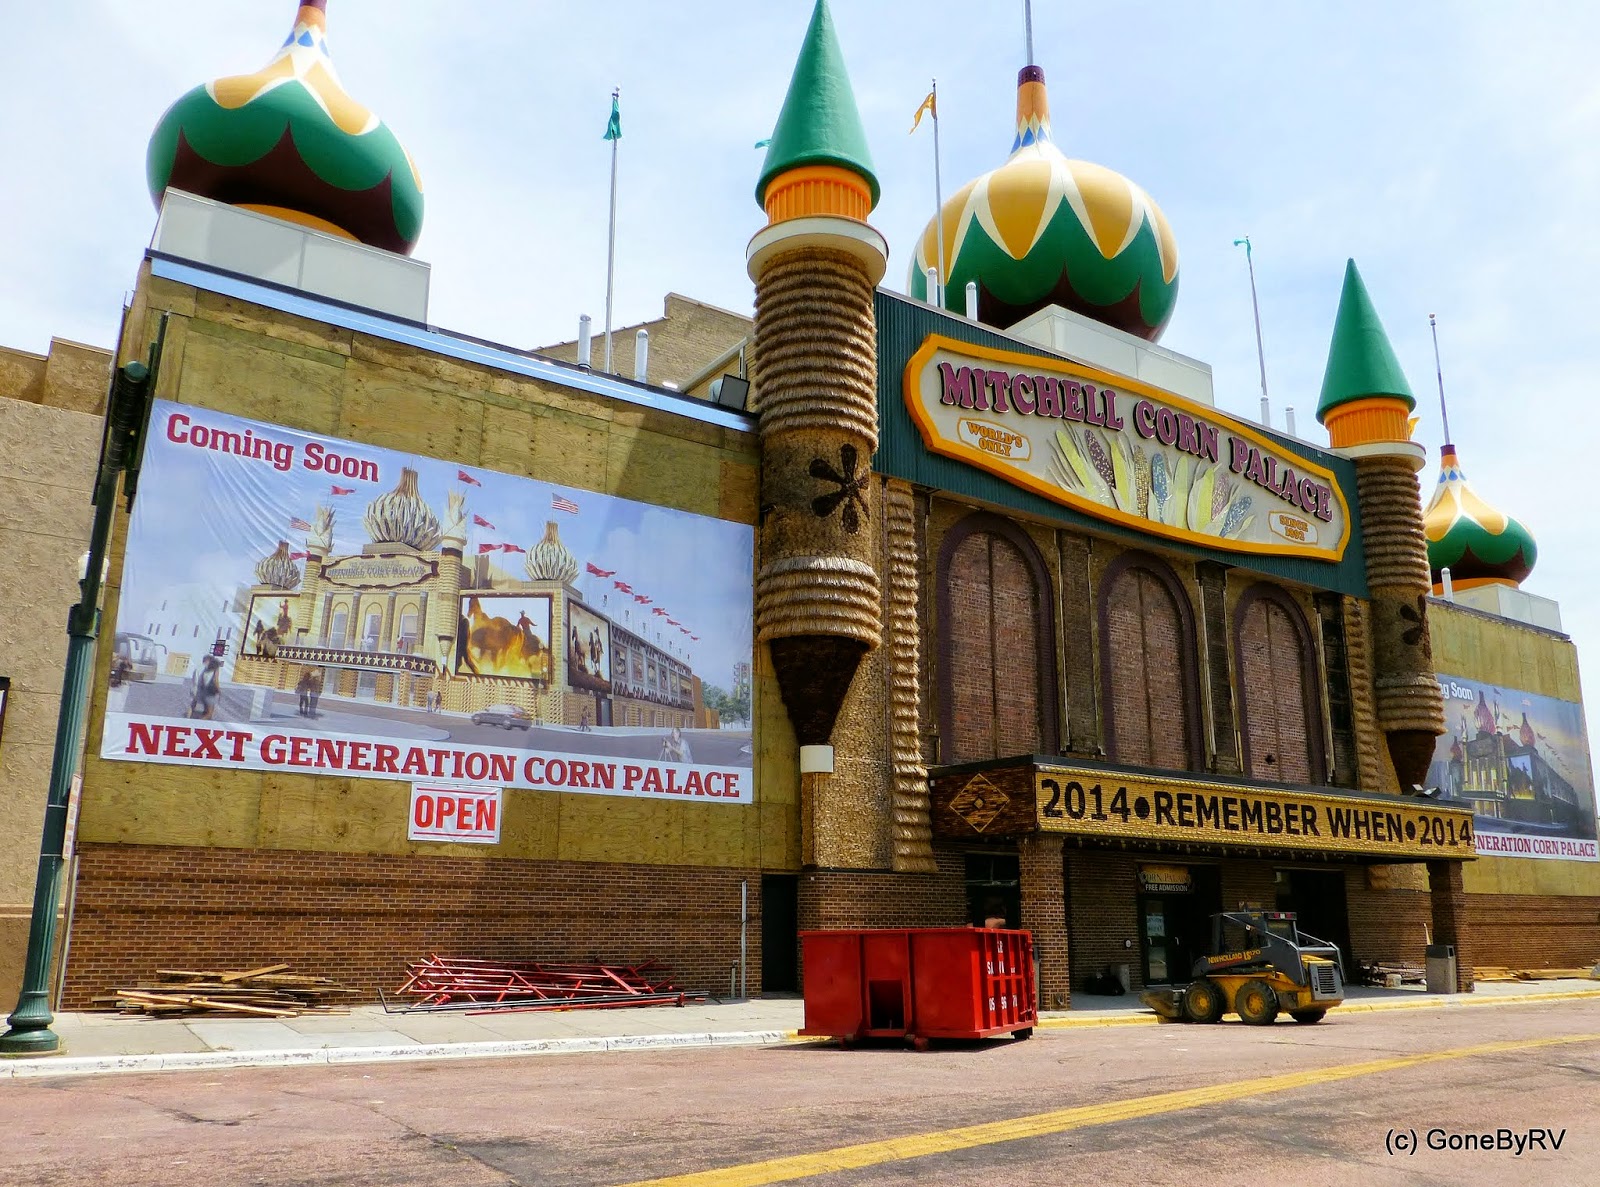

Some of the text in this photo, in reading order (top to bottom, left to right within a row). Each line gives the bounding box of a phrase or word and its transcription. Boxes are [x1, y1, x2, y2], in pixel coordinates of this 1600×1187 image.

[167, 413, 380, 483] Coming Soon
[938, 361, 1334, 523] MITCHELL CORN PALACE
[966, 421, 1023, 448] WORLD'S
[979, 437, 1012, 457] ONLY
[1450, 681, 1474, 701] Soon
[126, 722, 740, 799] NEXT GENERATION CORN PALACE
[413, 794, 497, 832] OPEN
[1043, 777, 1472, 848] 2014 REMEMBER WHEN 2014
[1475, 835, 1596, 857] NERATION CORN PALACE
[1145, 883, 1188, 892] FREE ADMISSION
